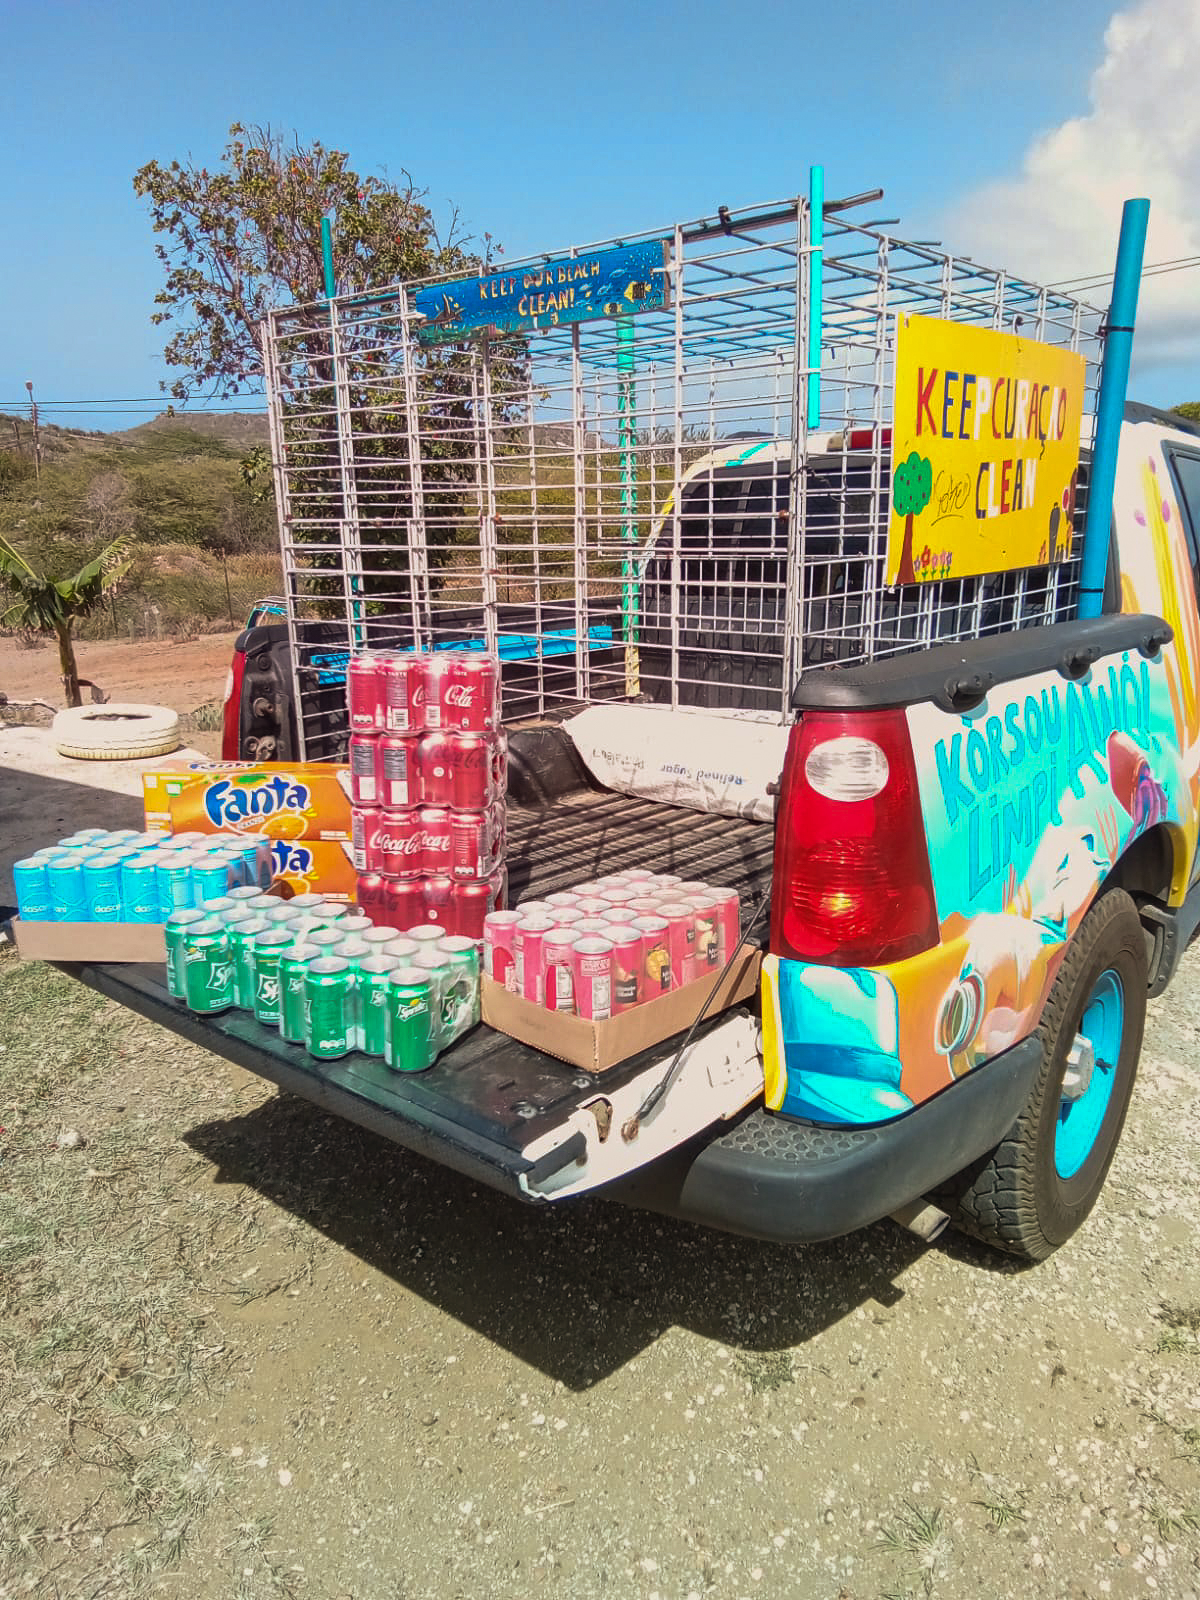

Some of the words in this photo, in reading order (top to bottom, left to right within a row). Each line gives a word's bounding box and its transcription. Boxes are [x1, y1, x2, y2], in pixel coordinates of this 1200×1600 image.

[478, 277, 517, 300] KEEP
[523, 269, 554, 289] OUR
[557, 260, 600, 284] BEACH
[518, 287, 575, 317] CLEAN!
[915, 367, 993, 441] KEEP
[975, 457, 1040, 520] CLEAN
[204, 775, 310, 828] Fanta
